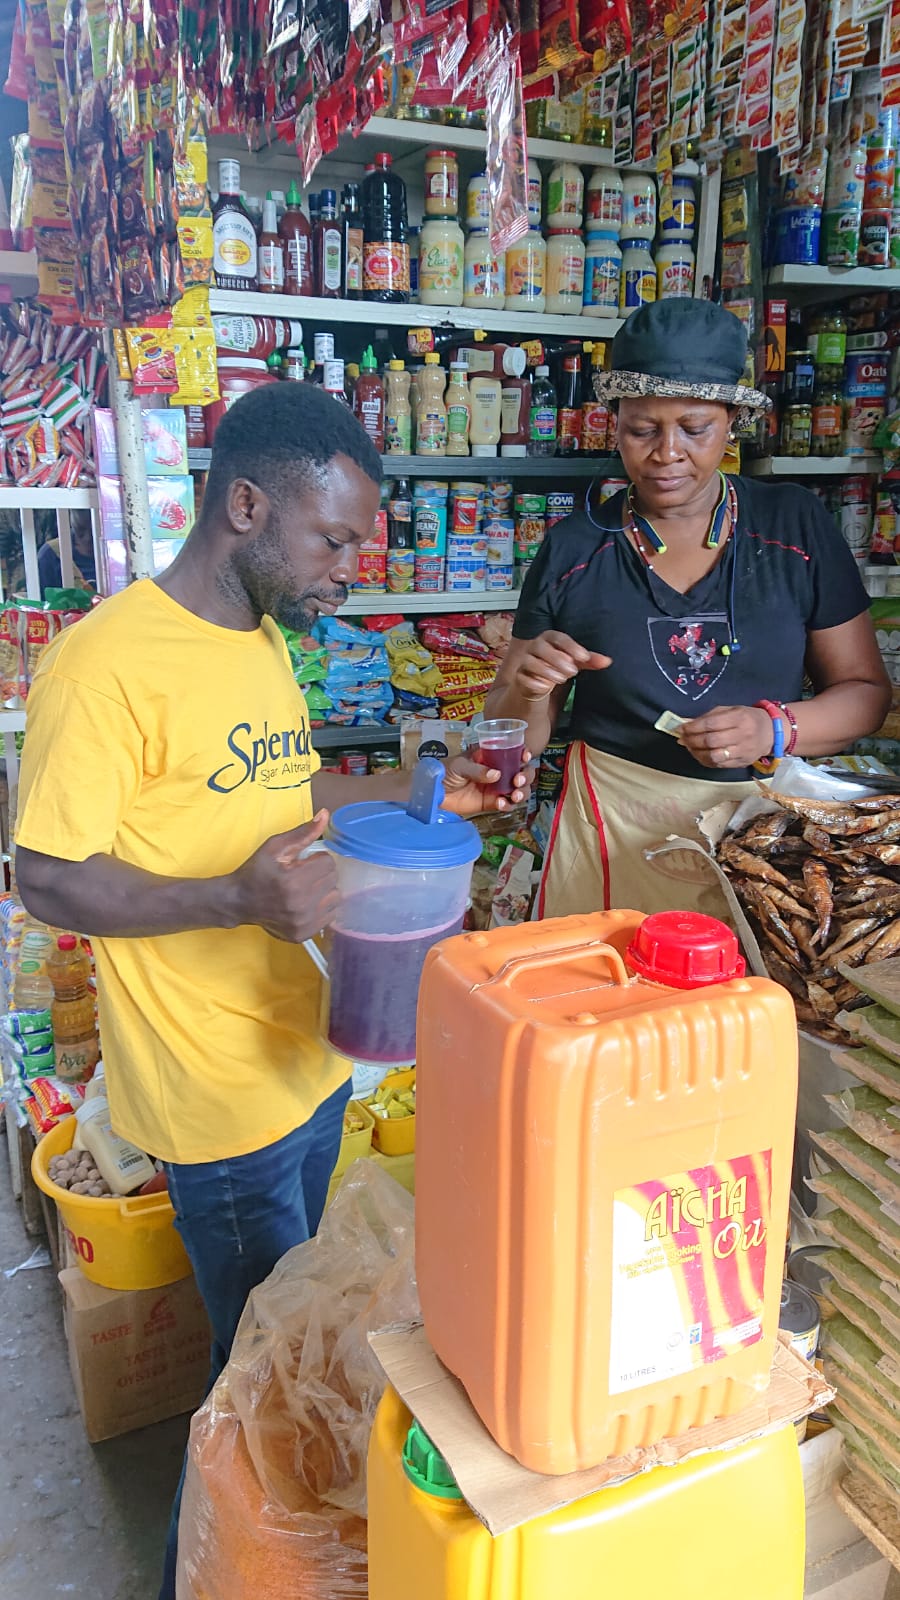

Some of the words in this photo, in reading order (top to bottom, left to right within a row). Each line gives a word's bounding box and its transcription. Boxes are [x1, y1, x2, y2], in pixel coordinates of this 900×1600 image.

[861, 365, 887, 377] Oats
[416, 521, 437, 531] BEANZ
[59, 1053, 87, 1070] Aya
[644, 1176, 747, 1242] AÏCHA
[713, 1218, 767, 1260] Oil
